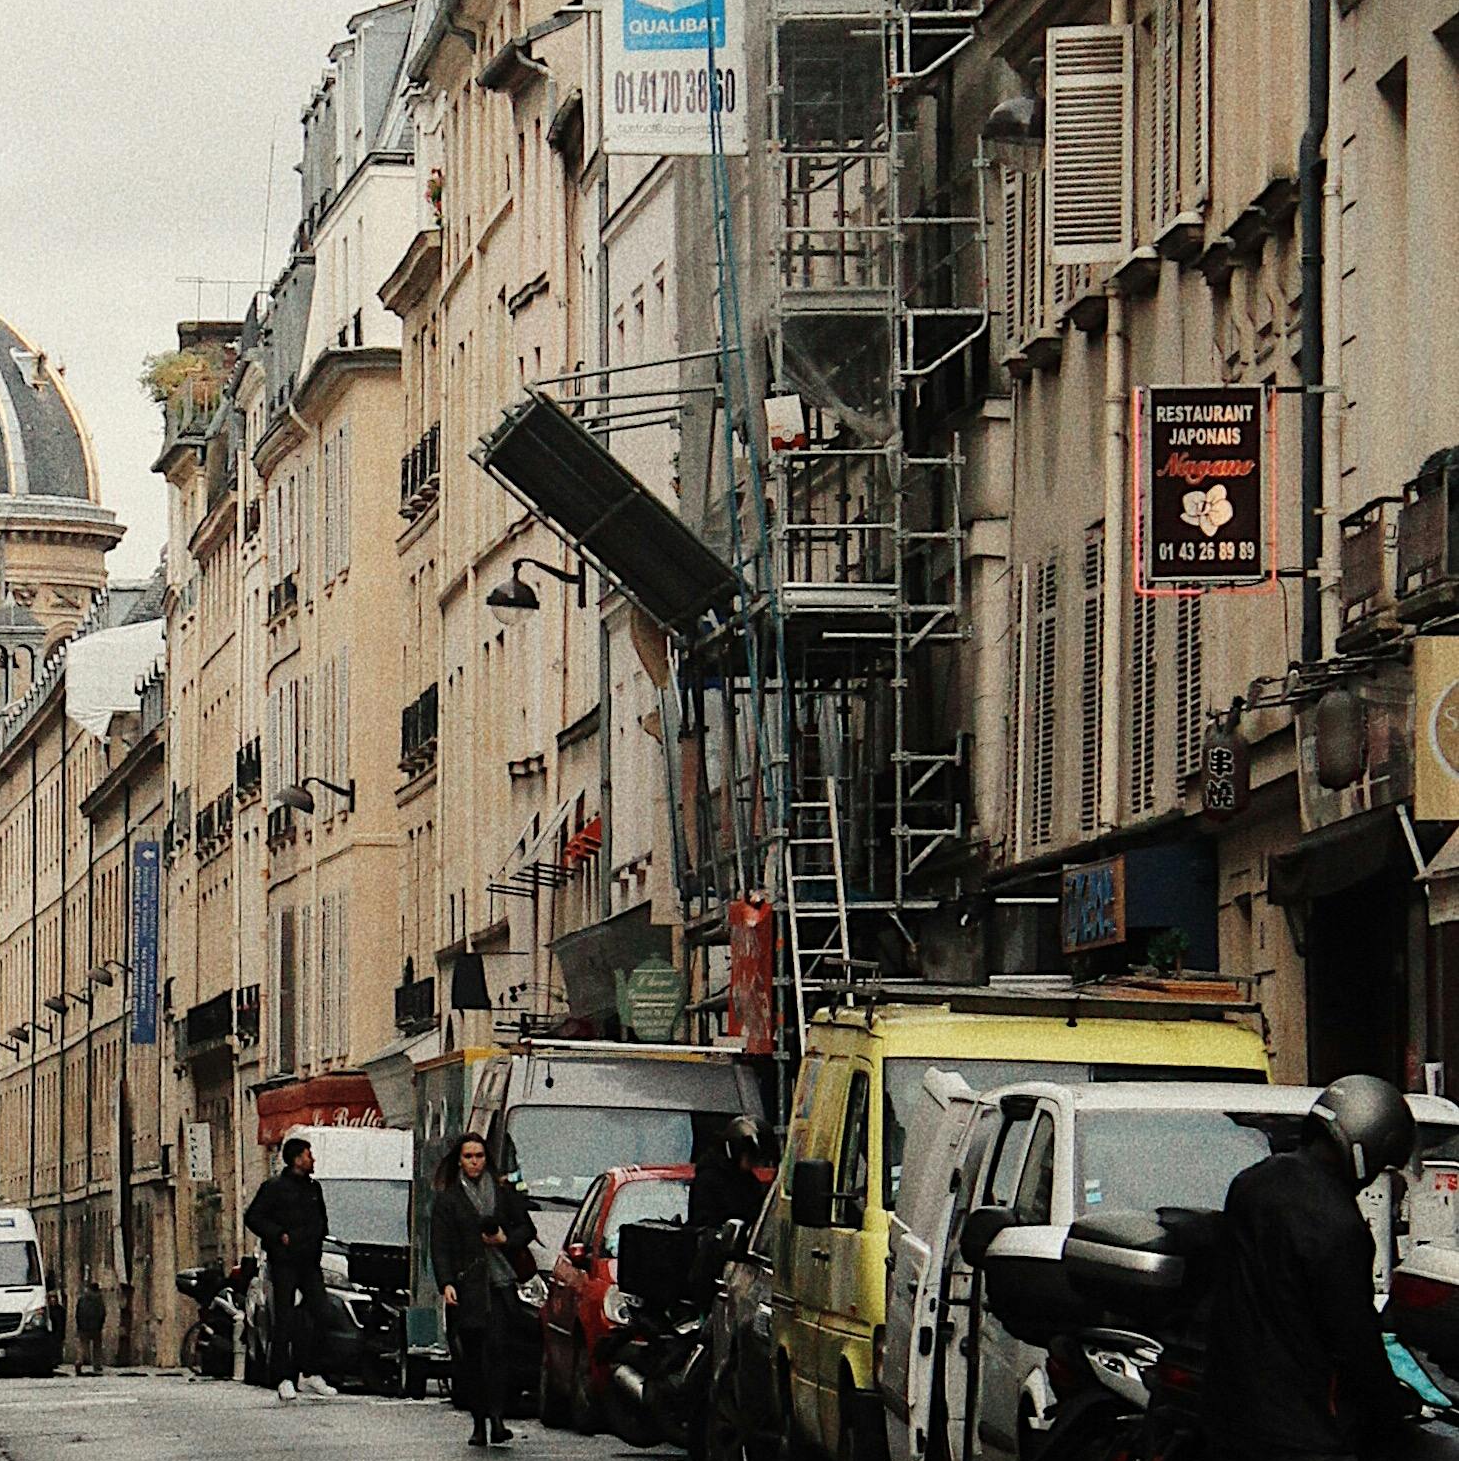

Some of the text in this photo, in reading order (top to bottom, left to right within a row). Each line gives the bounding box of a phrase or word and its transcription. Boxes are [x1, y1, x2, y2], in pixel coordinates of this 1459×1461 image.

[628, 16, 720, 35] QUALIBAT
[1156, 404, 1254, 423] RESTAURANT
[1168, 426, 1242, 445] JAPONAIS
[1159, 542, 1255, 561] 01 43 26 89 89
